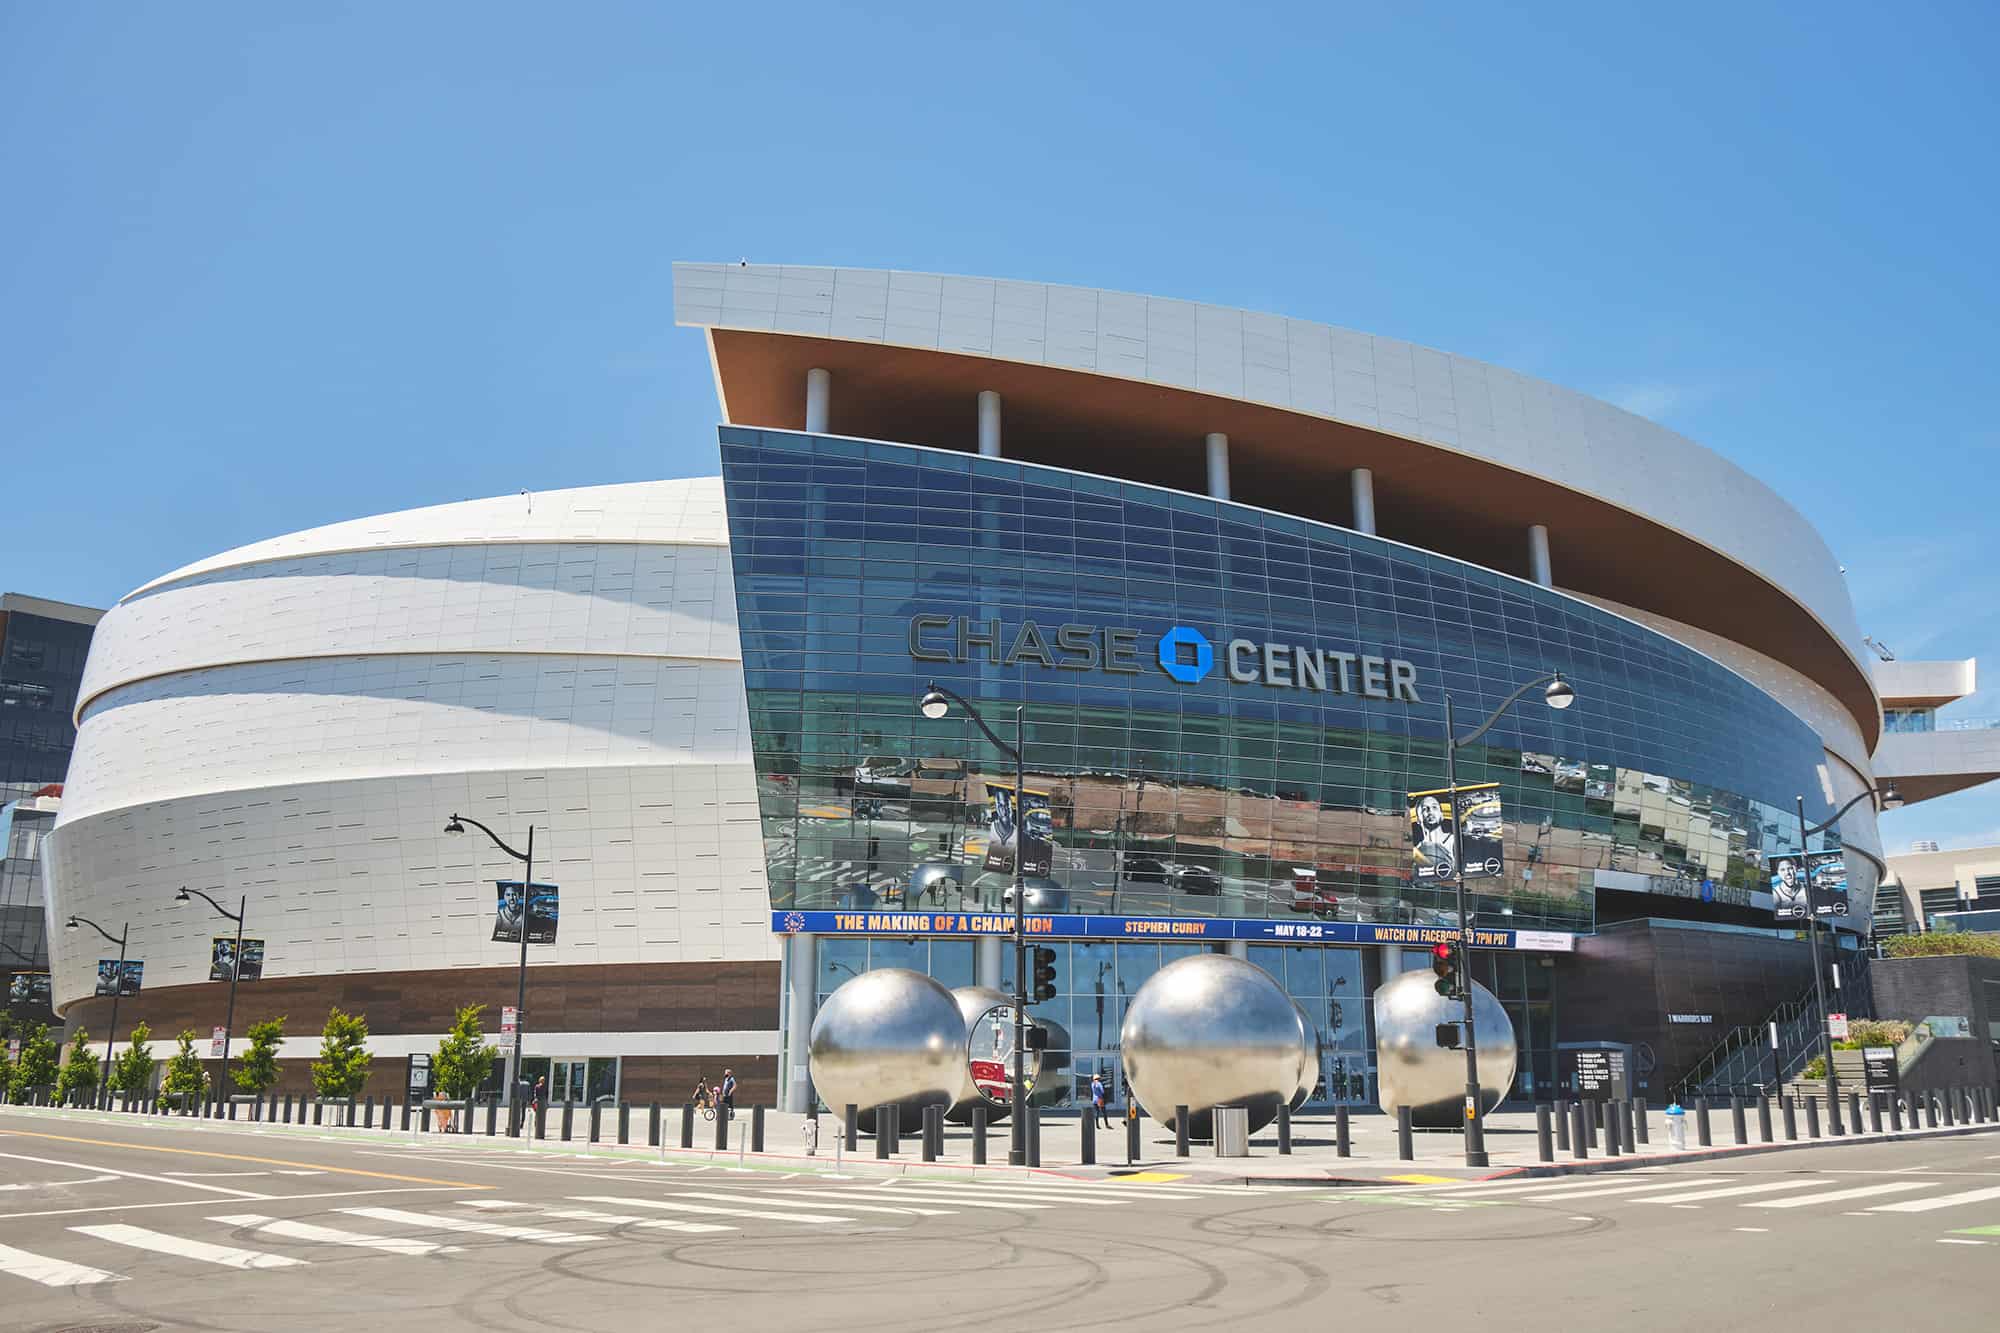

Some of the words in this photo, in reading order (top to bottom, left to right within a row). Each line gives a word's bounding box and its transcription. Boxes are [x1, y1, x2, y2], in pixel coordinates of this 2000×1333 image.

[909, 612, 1144, 672] CHASE
[1227, 638, 1422, 703] CENTER
[834, 914, 865, 930] THE
[867, 915, 930, 931] MAKING
[934, 915, 956, 931] OF
[957, 915, 967, 931] A
[971, 916, 1053, 933] CHAMION
[1124, 921, 1170, 934] STEPHEN
[1172, 922, 1206, 935] CURRY
[1274, 925, 1295, 937] MAY
[1296, 925, 1323, 938] 18-22
[1375, 927, 1406, 941] WATCH
[1407, 928, 1419, 942] ON
[1420, 929, 1462, 943] FACEBOO
[1475, 932, 1493, 945] 7PM
[1493, 932, 1509, 945] PDT
